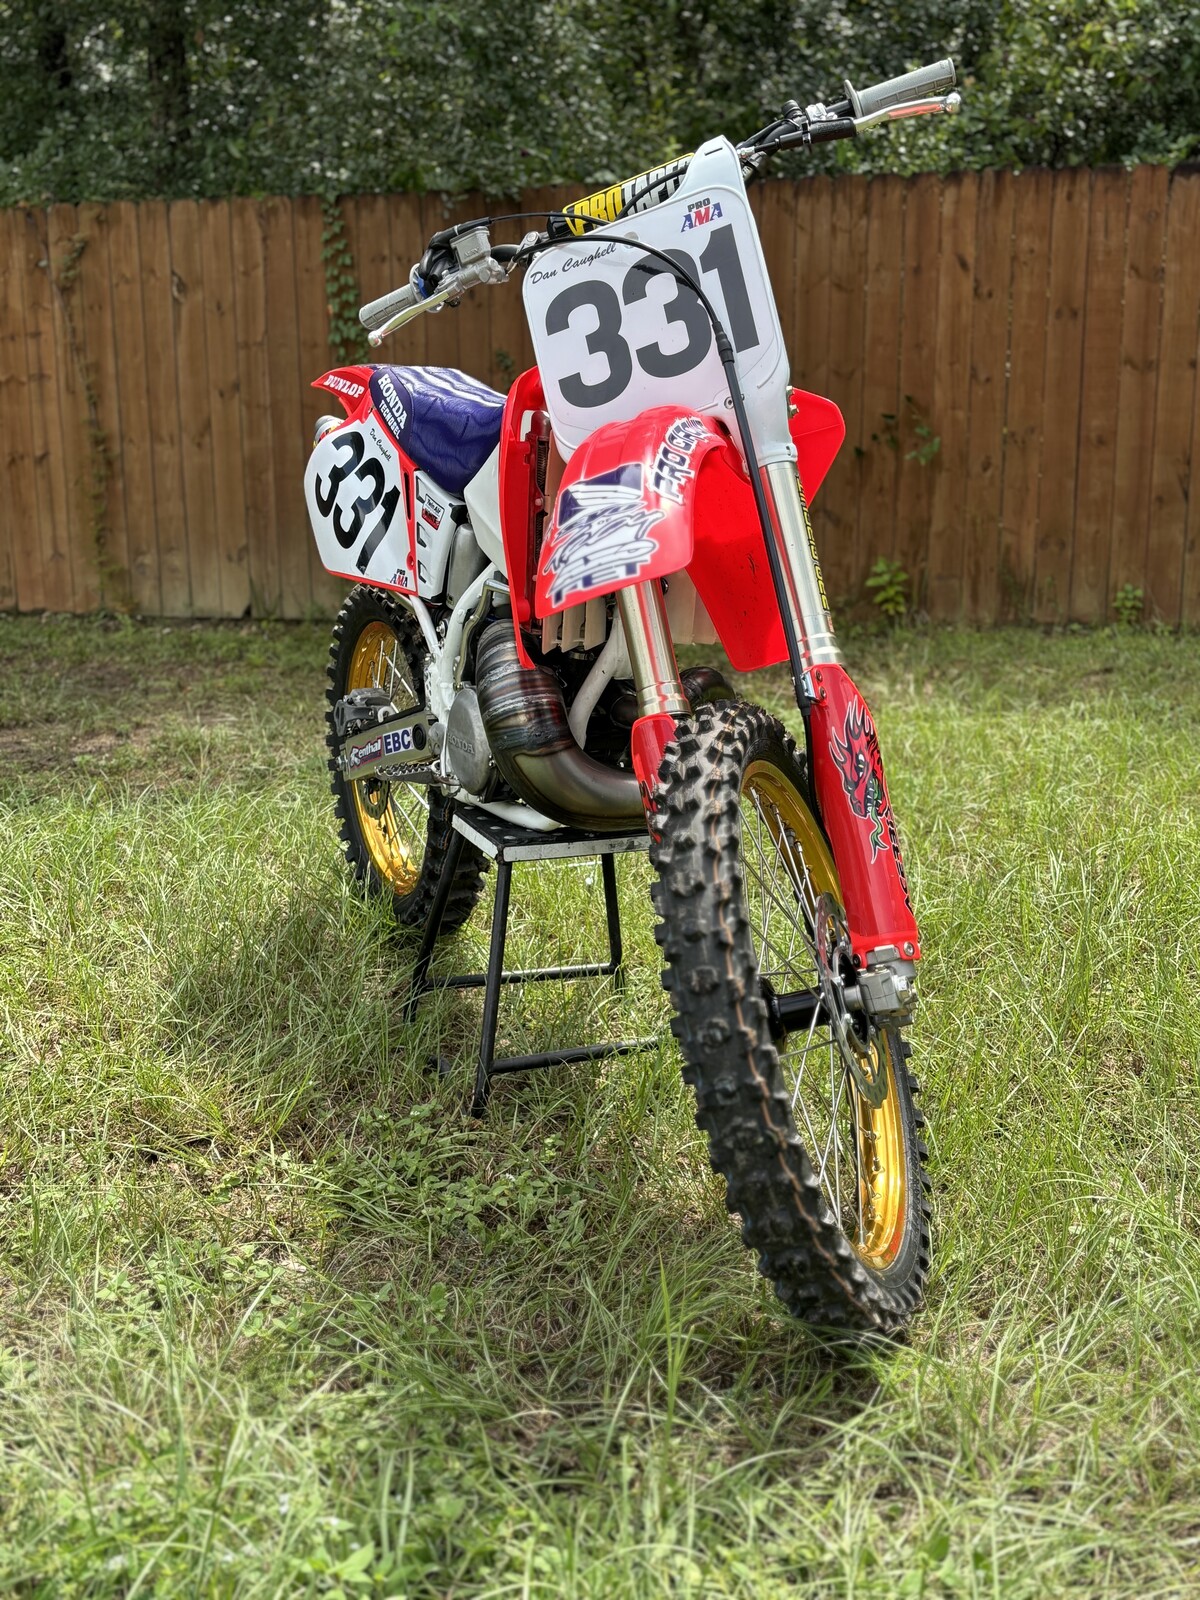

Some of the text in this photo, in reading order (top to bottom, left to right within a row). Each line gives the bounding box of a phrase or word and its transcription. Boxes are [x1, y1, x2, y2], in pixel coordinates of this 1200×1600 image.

[680, 202, 723, 233] AMA
[687, 197, 711, 213] PRO
[530, 242, 617, 285] Dan Caughell
[545, 223, 760, 408] 331
[325, 376, 365, 398] DUNLOP
[378, 374, 407, 429] HONDA
[653, 445, 693, 502] PRO
[315, 431, 401, 575] 331
[390, 574, 408, 587] AMA
[350, 738, 381, 768] Renthal
[384, 730, 411, 754] EBC
[448, 733, 475, 756] HONDA
